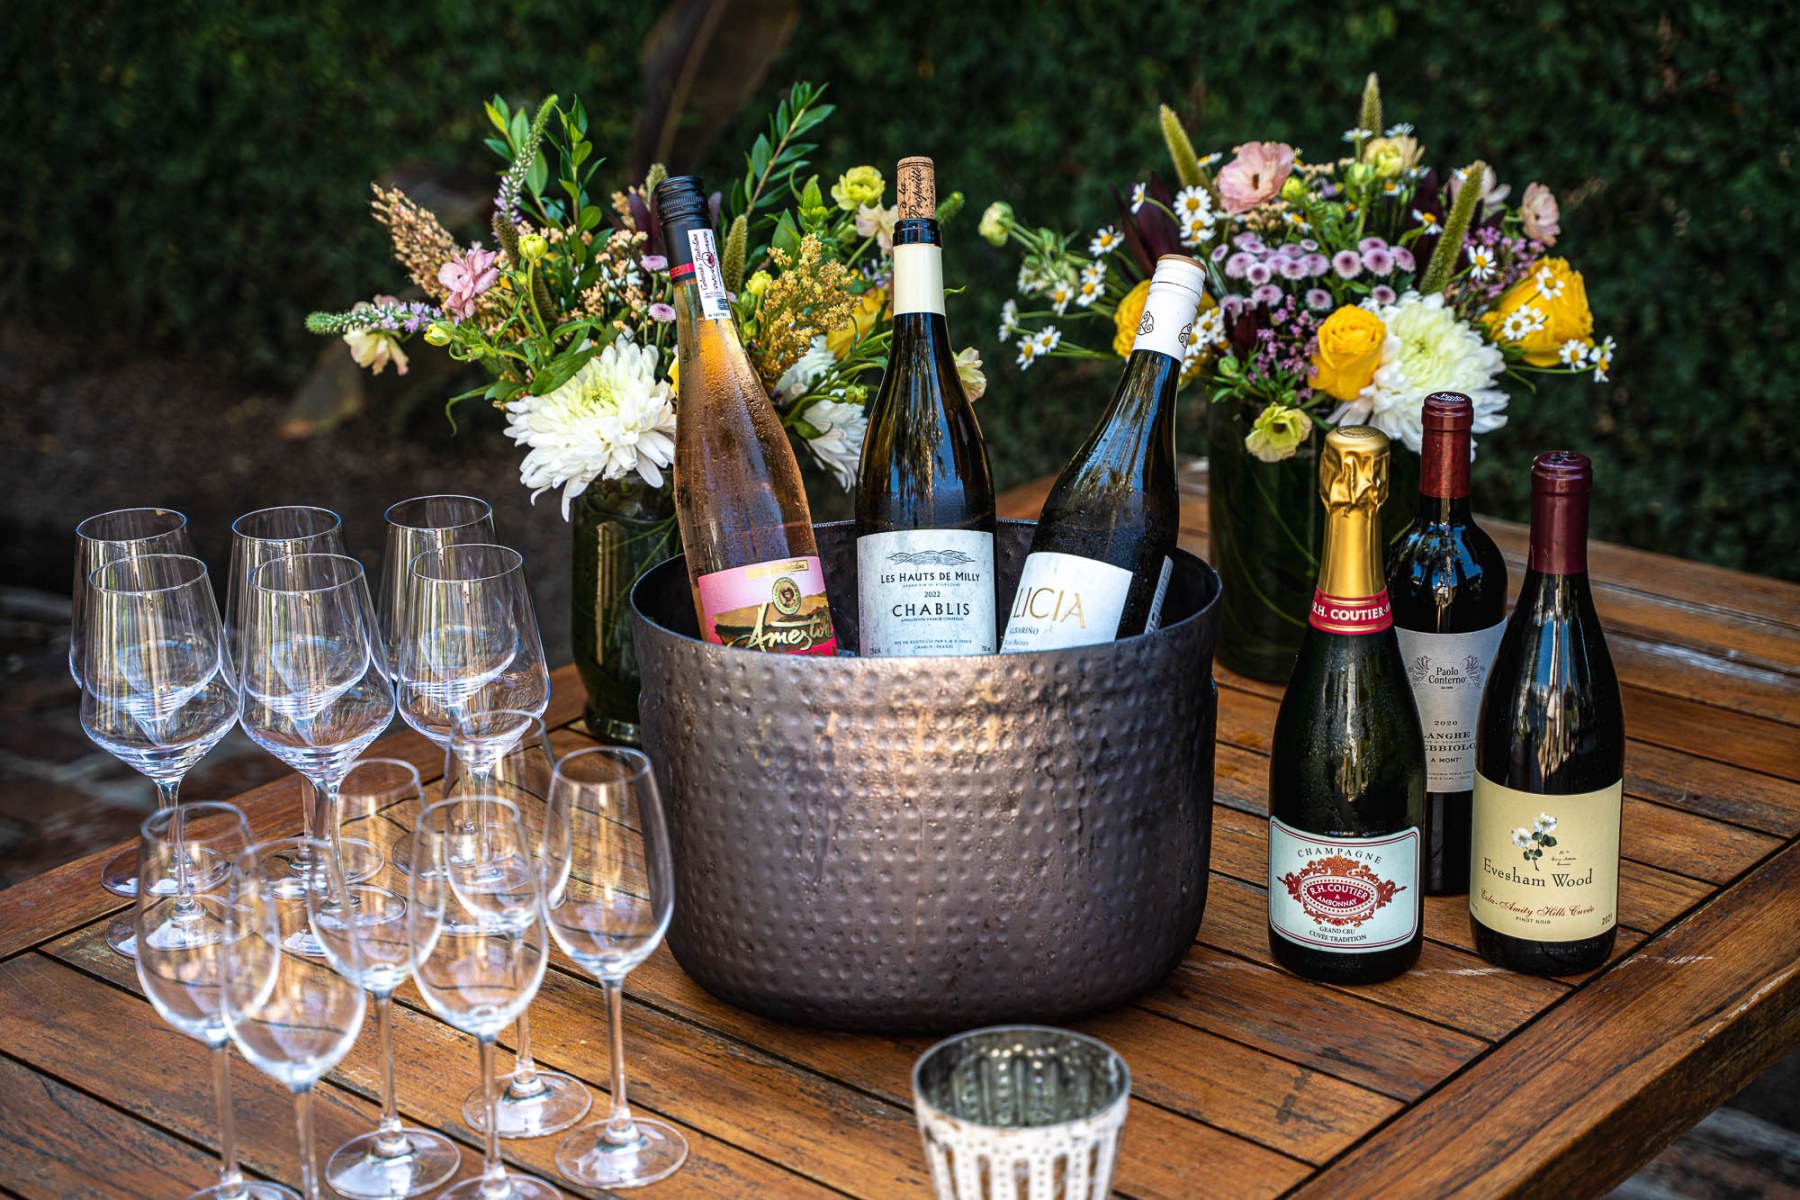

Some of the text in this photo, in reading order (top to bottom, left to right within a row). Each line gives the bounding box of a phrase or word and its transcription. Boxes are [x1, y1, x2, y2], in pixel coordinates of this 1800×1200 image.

[881, 571, 980, 584] LES HAUTS DE MILLY
[892, 602, 970, 617] CHABLIS
[1012, 586, 1086, 629] LICIA
[1436, 666, 1459, 676] Paolo
[1428, 675, 1466, 685] Conterno
[1424, 731, 1471, 740] ANGHE
[1424, 742, 1476, 752] EBBIOLO
[1297, 847, 1382, 864] CHAMPAGNE
[1483, 857, 1546, 887] Evesham
[1551, 867, 1593, 888] Wood
[1309, 883, 1369, 900] R.H. COUTIER
[1316, 896, 1357, 907] AMBONNAY
[1536, 905, 1566, 917] Hills
[1515, 916, 1533, 924] PINOT
[1319, 926, 1341, 934] GRAND
[1330, 933, 1367, 943] TRADITION
